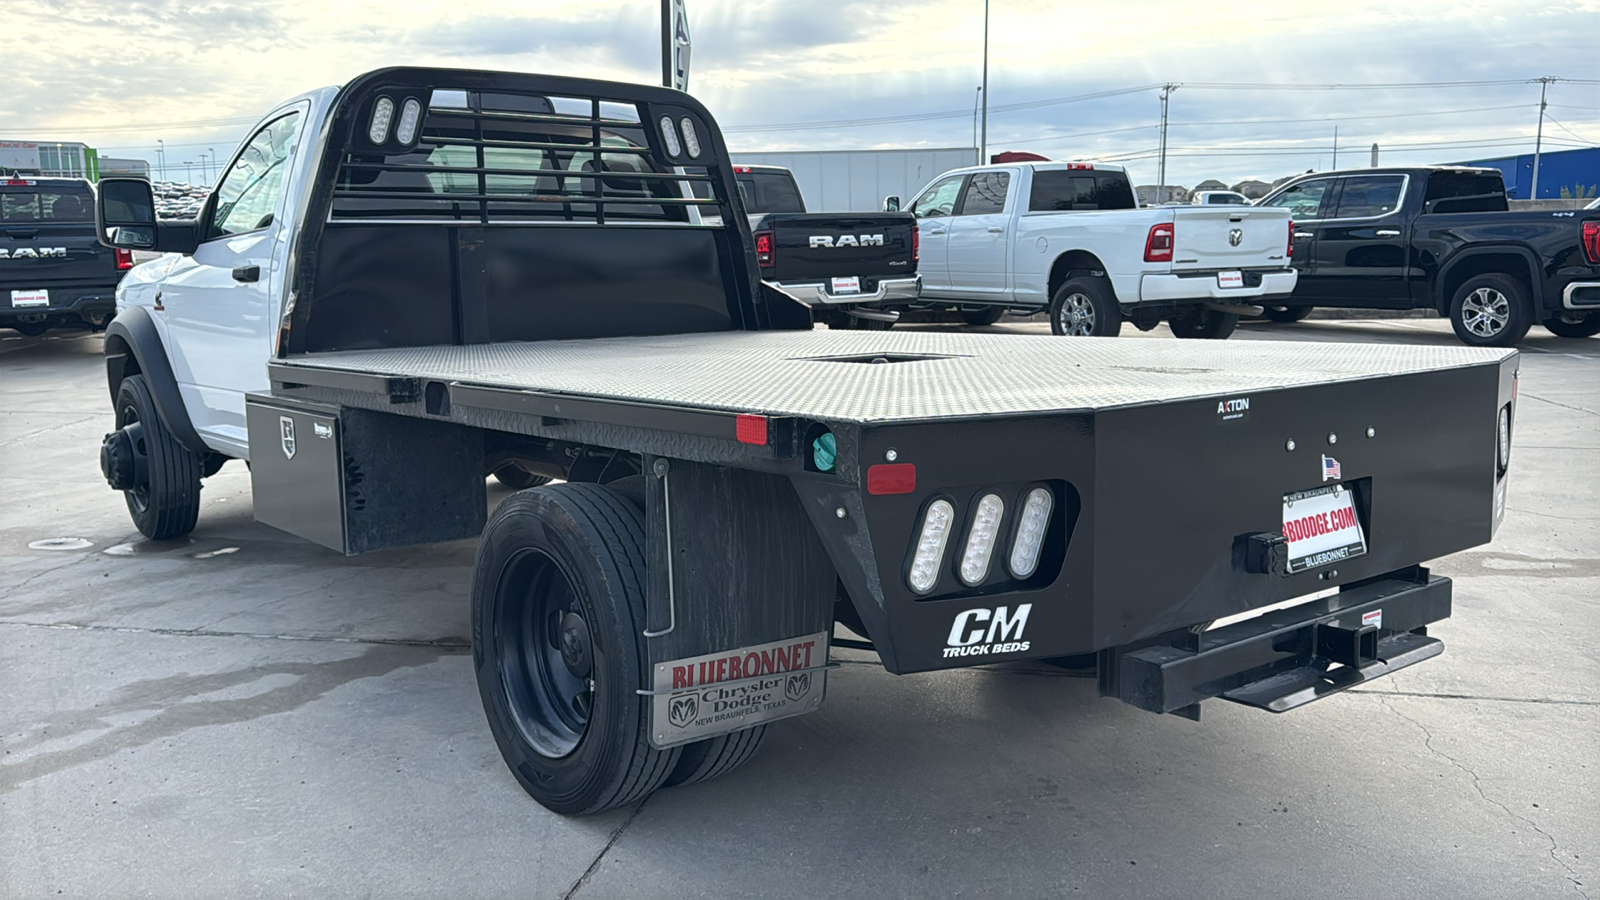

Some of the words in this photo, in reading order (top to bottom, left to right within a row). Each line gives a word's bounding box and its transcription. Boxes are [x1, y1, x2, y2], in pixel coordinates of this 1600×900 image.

[809, 234, 884, 248] RAM
[1217, 398, 1250, 414] AXTON
[1289, 492, 1303, 501] NEW
[1304, 485, 1337, 499] BRAUNFELS
[1305, 547, 1349, 567] BLUEBONNET
[947, 603, 1032, 647] CM
[943, 644, 990, 658] TRUCK
[992, 641, 1031, 654] BEDS
[671, 641, 815, 695] BLUEBONNET
[701, 677, 783, 703] Chrysler
[713, 692, 771, 713] Dodge
[695, 715, 713, 727] NEW
[714, 706, 762, 723] BRAUNFELS,
[763, 699, 786, 712] TEXAS
